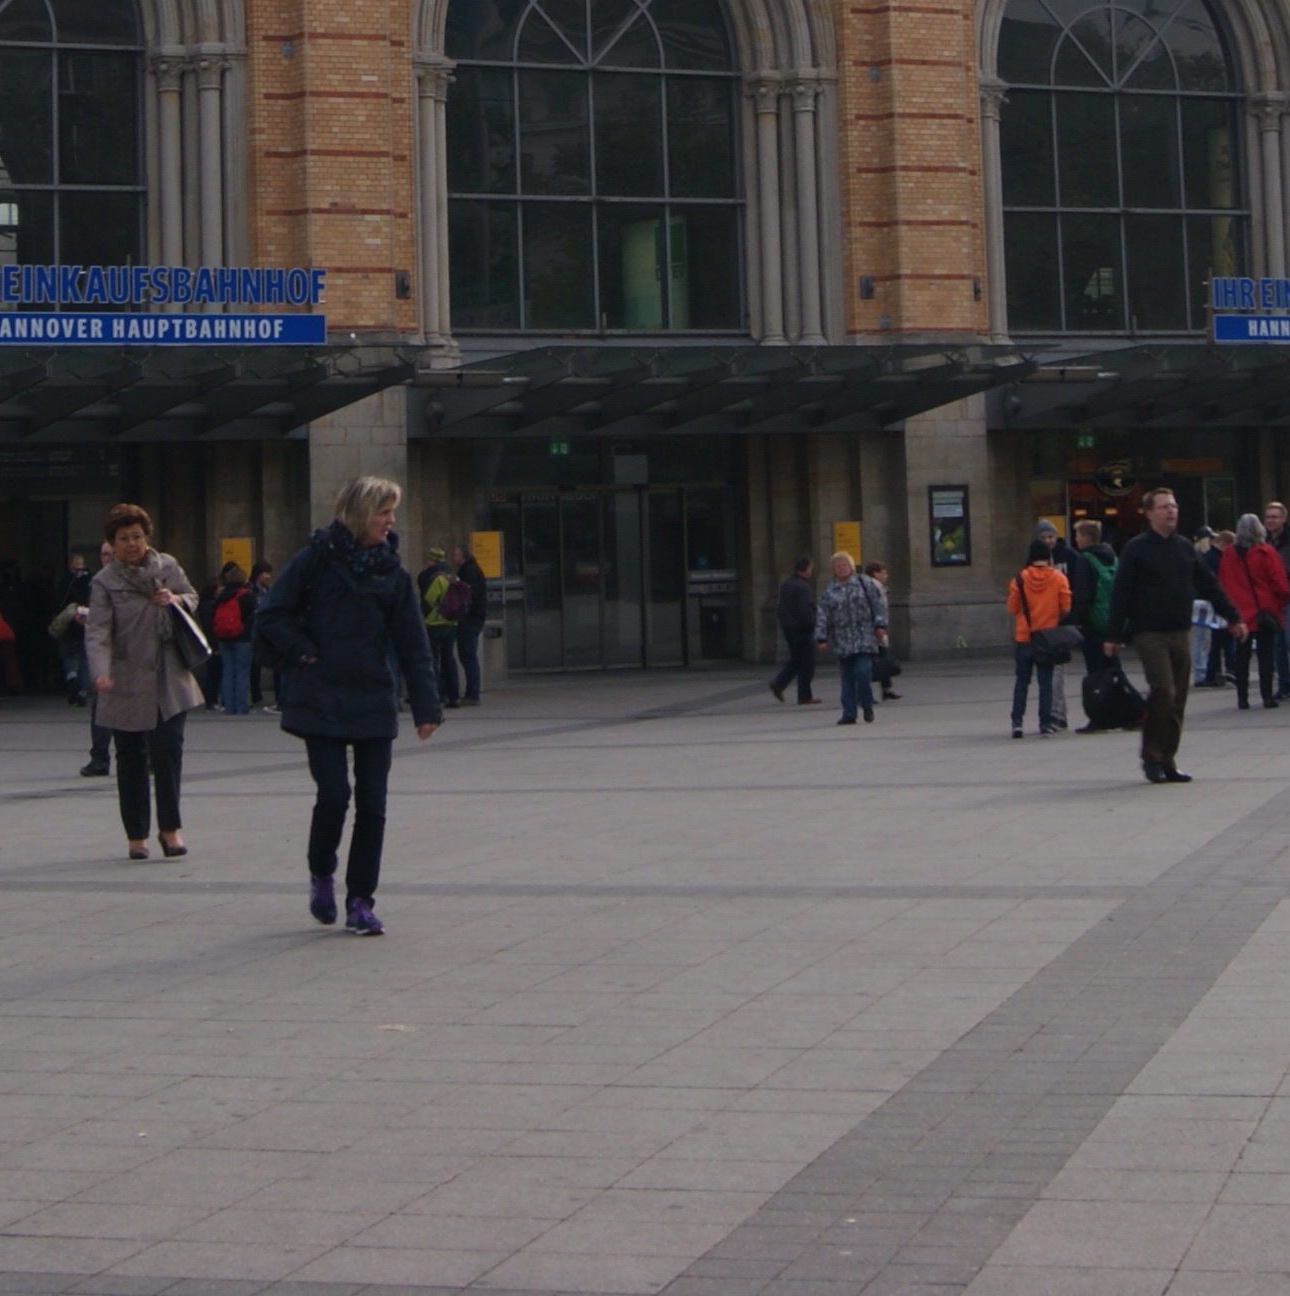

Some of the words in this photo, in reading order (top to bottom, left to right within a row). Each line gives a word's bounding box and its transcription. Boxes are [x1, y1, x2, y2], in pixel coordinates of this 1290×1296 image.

[1, 264, 328, 305] EINKAUFSBAHNHOF
[1213, 277, 1256, 310] IHR
[112, 317, 284, 340] HAUPTBAHNHOF
